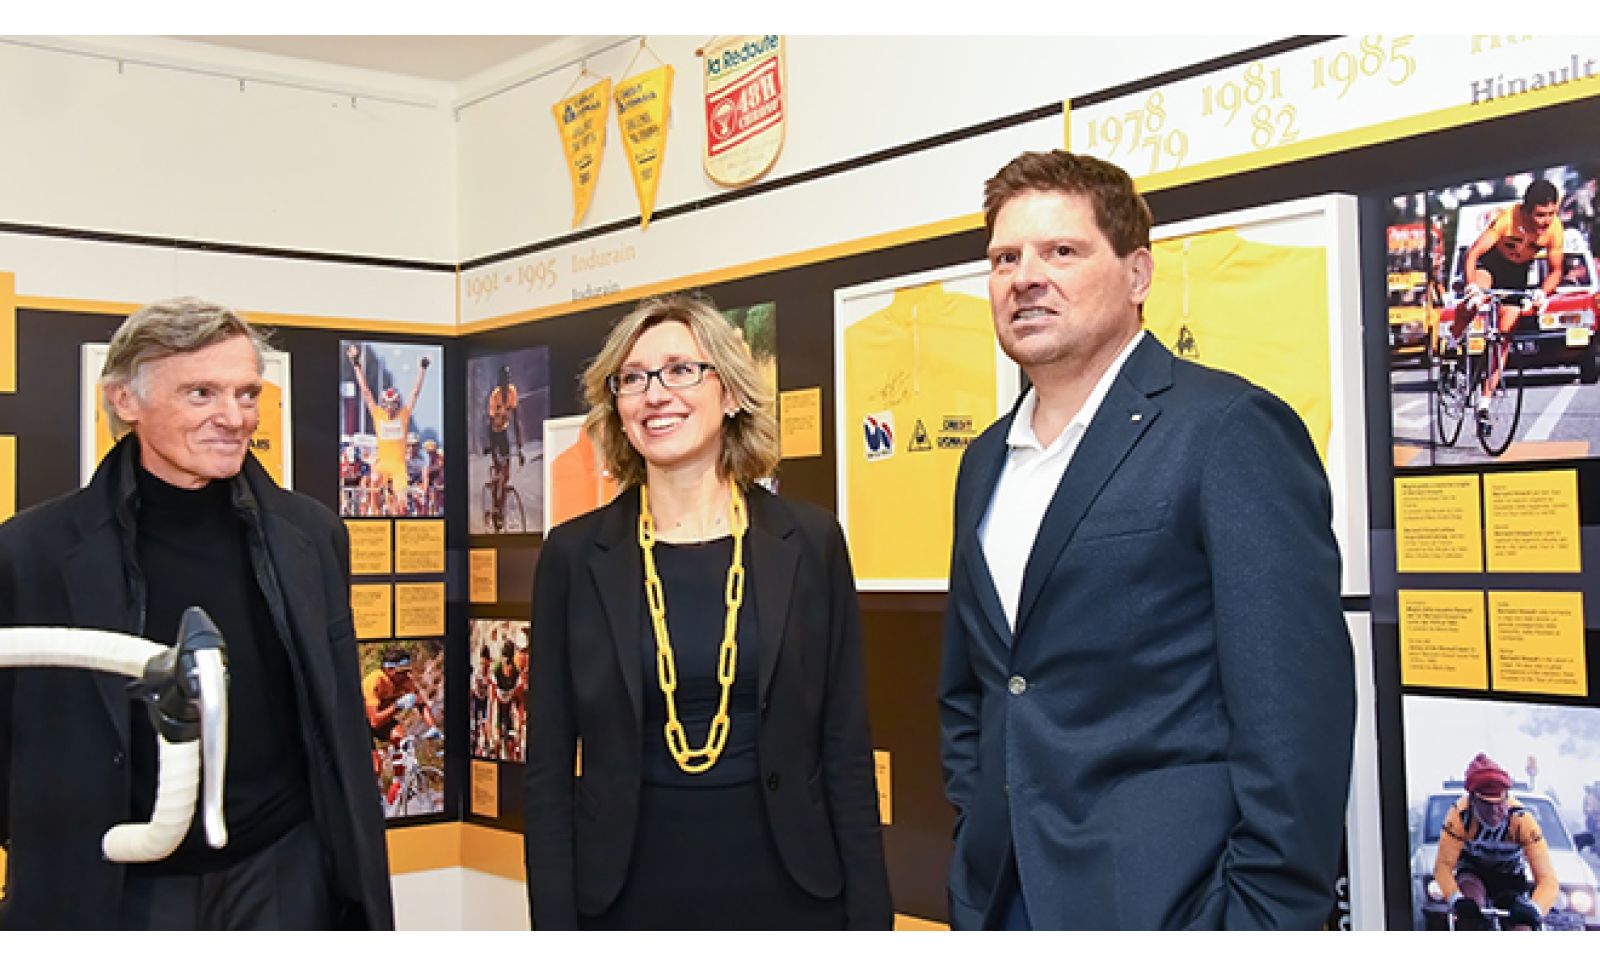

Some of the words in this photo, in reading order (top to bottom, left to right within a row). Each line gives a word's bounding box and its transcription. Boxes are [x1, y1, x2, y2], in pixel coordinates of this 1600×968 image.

[1312, 35, 1417, 100] 1985
[1470, 54, 1597, 106] Hinault
[1202, 61, 1284, 128] 1981
[1087, 91, 1167, 159] 1978
[1141, 128, 1190, 172] 79
[1251, 103, 1301, 149] 82
[466, 271, 499, 305] 1991
[517, 257, 559, 294] 1995
[571, 243, 637, 273] Indurain
